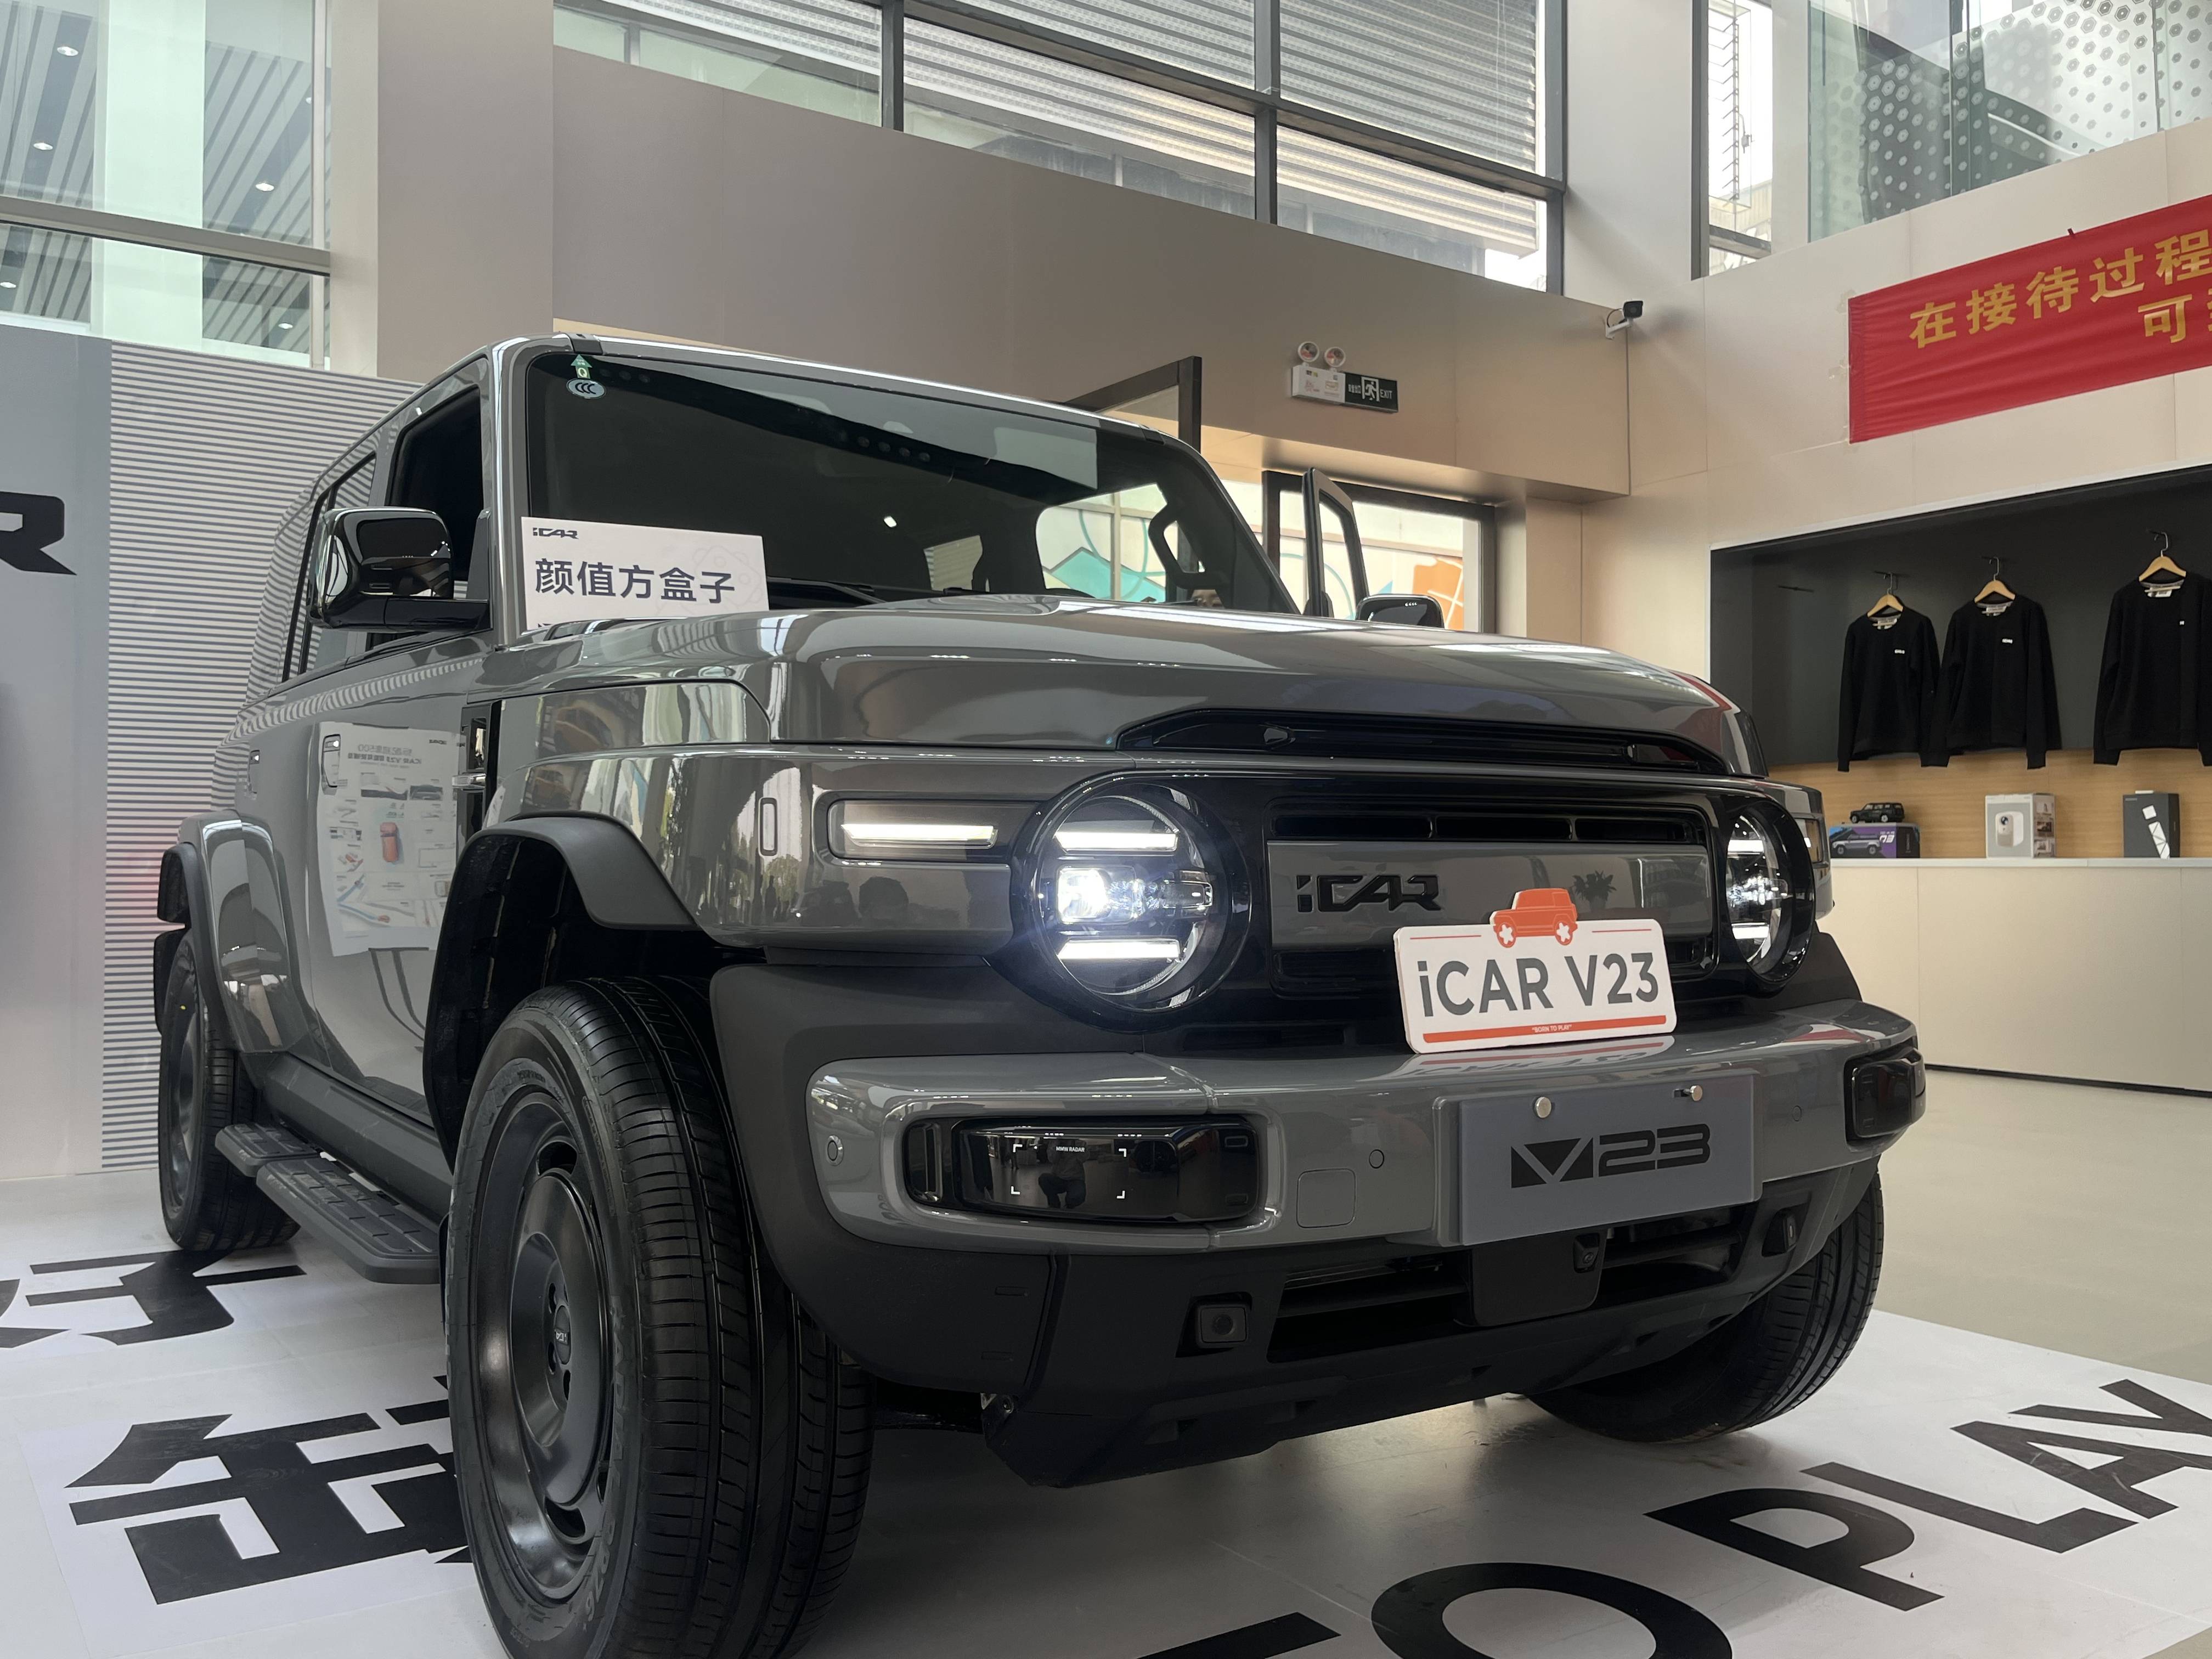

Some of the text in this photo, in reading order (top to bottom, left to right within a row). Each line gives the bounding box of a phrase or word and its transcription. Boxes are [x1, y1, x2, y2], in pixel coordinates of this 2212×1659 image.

[1909, 229, 2212, 349] 在接待过程
[2138, 288, 2212, 343] 可
[1380, 388, 1392, 399] EXIT
[535, 558, 735, 604] 颜值方盒子
[1296, 874, 1441, 912] iCAR
[1418, 951, 1659, 1018] iCAR V23
[1511, 1123, 1711, 1189] V23
[1642, 1379, 2212, 1612] PLAY
